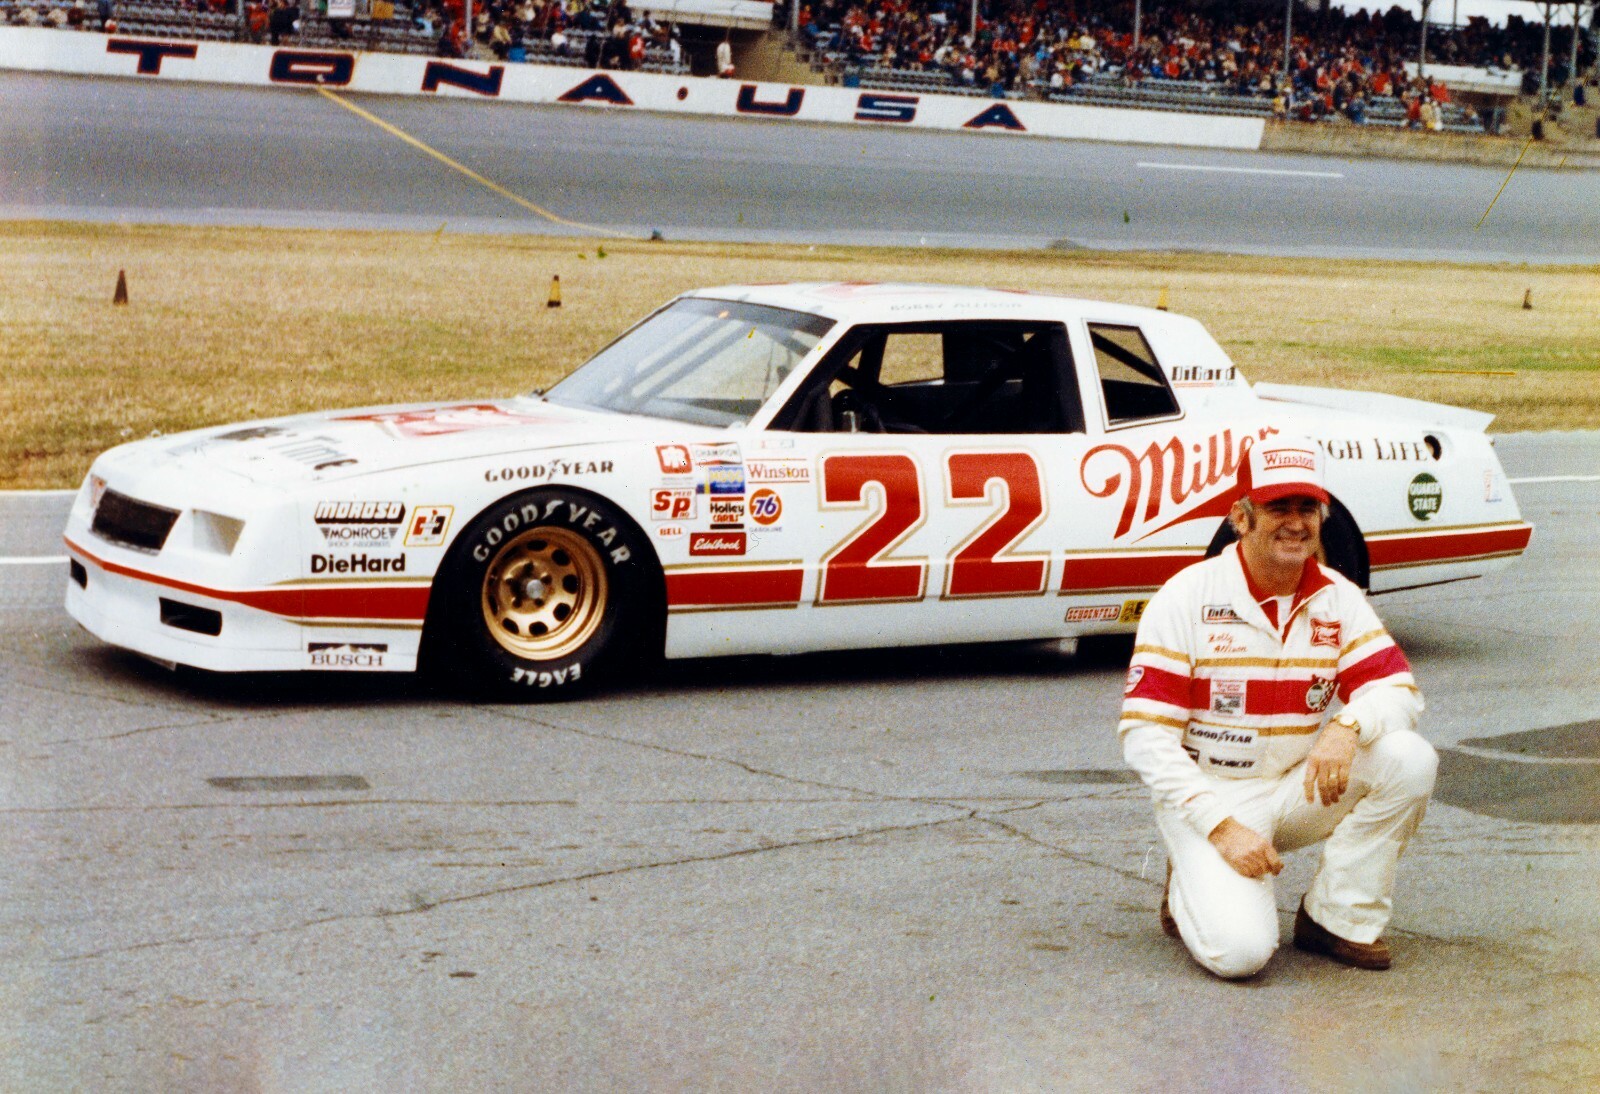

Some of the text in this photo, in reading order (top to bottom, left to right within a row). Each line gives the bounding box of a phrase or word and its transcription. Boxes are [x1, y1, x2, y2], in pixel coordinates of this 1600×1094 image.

[1305, 436, 1428, 461] GH LIFE
[747, 463, 810, 479] Winston
[710, 503, 744, 517] Holley
[755, 496, 778, 515] 76
[1413, 497, 1438, 511] STATE
[315, 501, 406, 525] MOROSO
[330, 527, 389, 540] MONROE
[660, 528, 683, 536] BELL
[815, 447, 1050, 606] 22
[693, 538, 741, 550] Edelbrock
[311, 553, 405, 574] DieHard
[310, 654, 384, 667] BUSCH
[510, 662, 582, 688] EAGLE
